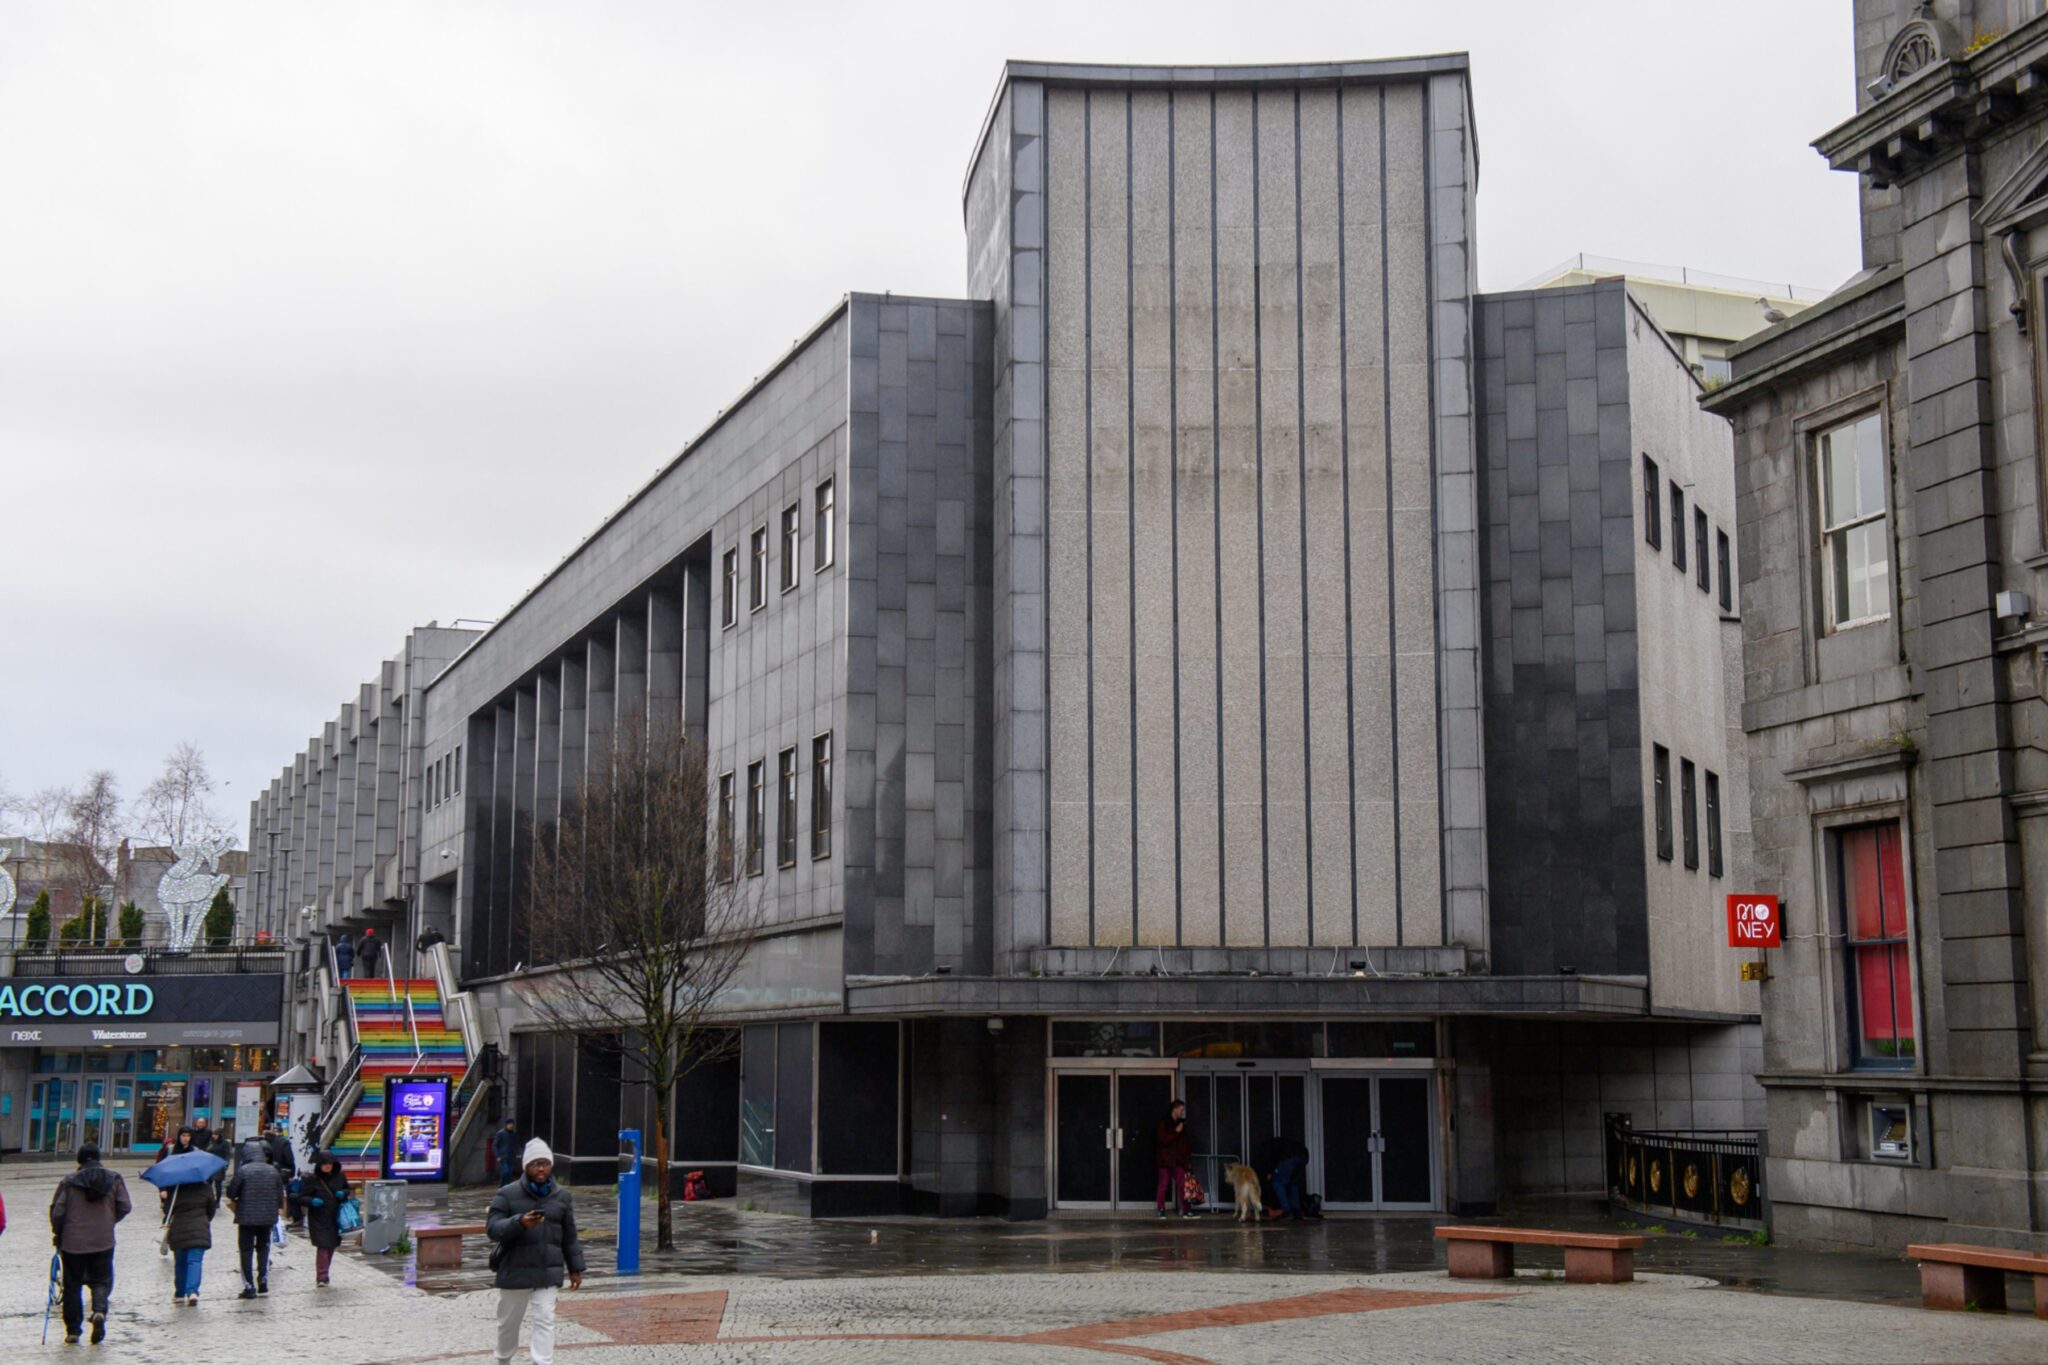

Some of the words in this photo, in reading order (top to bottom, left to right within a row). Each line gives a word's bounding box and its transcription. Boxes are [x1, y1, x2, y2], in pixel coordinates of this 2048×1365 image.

[1738, 921, 1775, 939] NEY
[0, 984, 154, 1016] ACCORD
[11, 1030, 42, 1041] next
[91, 1029, 147, 1040] Waterstones
